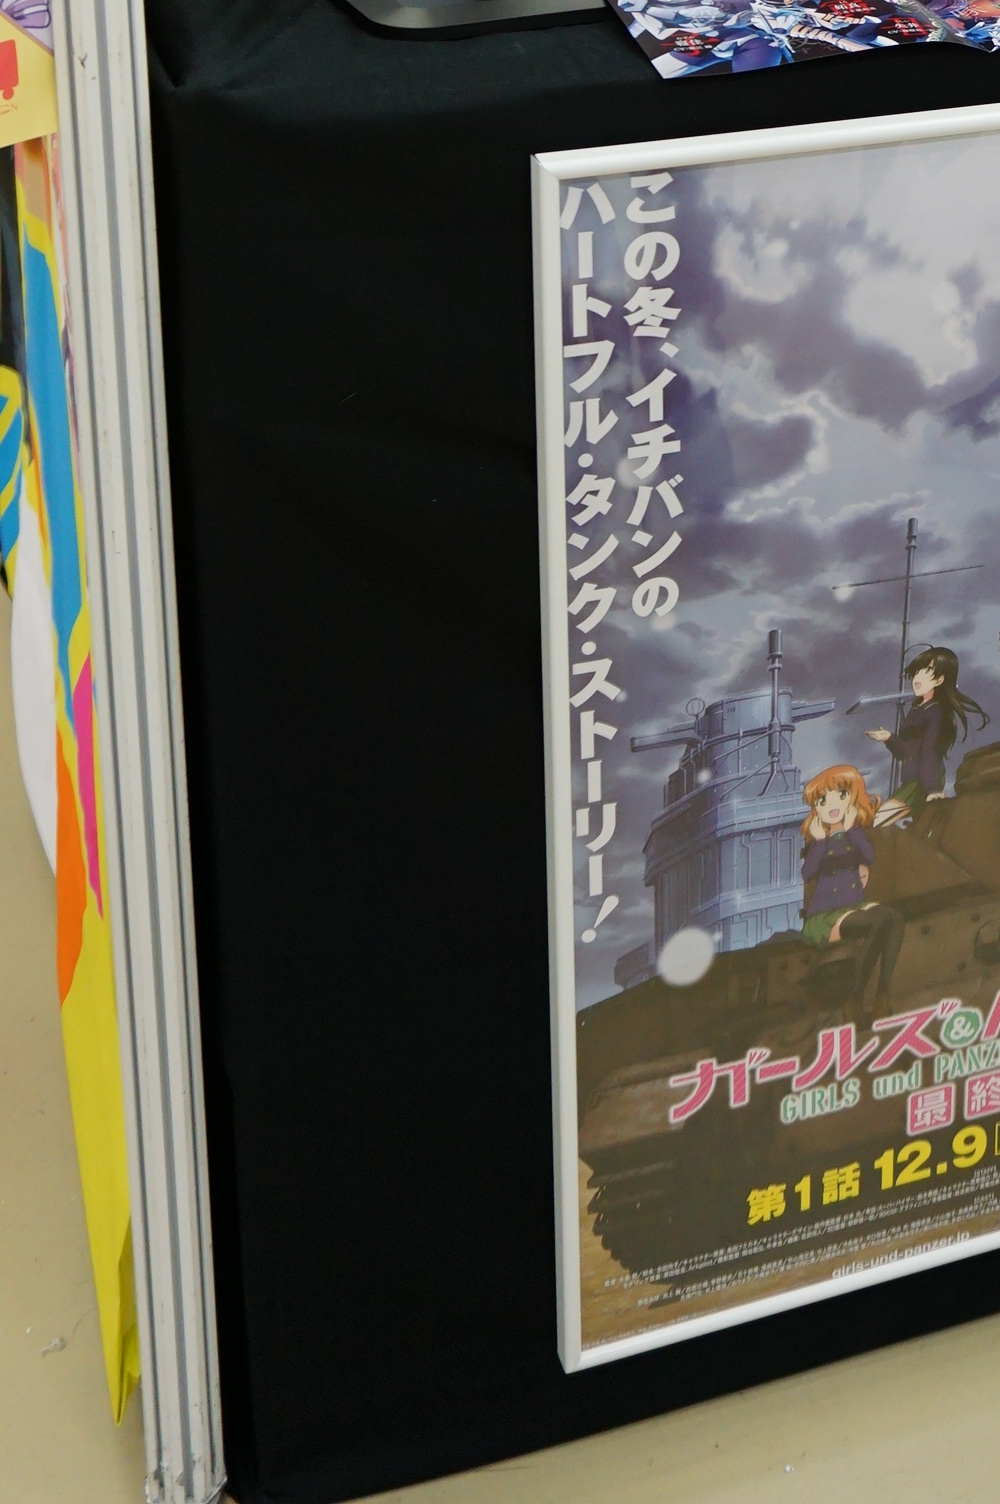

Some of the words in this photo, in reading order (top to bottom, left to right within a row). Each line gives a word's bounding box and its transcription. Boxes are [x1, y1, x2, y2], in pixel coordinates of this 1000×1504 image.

[623, 171, 684, 618] この冬、イチバンの
[559, 182, 623, 944] ハートフル・タンク・ストーリー!
[780, 1078, 860, 1125] GIRLS
[873, 1060, 922, 1100] und
[746, 1161, 860, 1226] 第1話
[874, 1124, 988, 1191] 12.9
[831, 1228, 970, 1280] girls-und-panzer.jp
